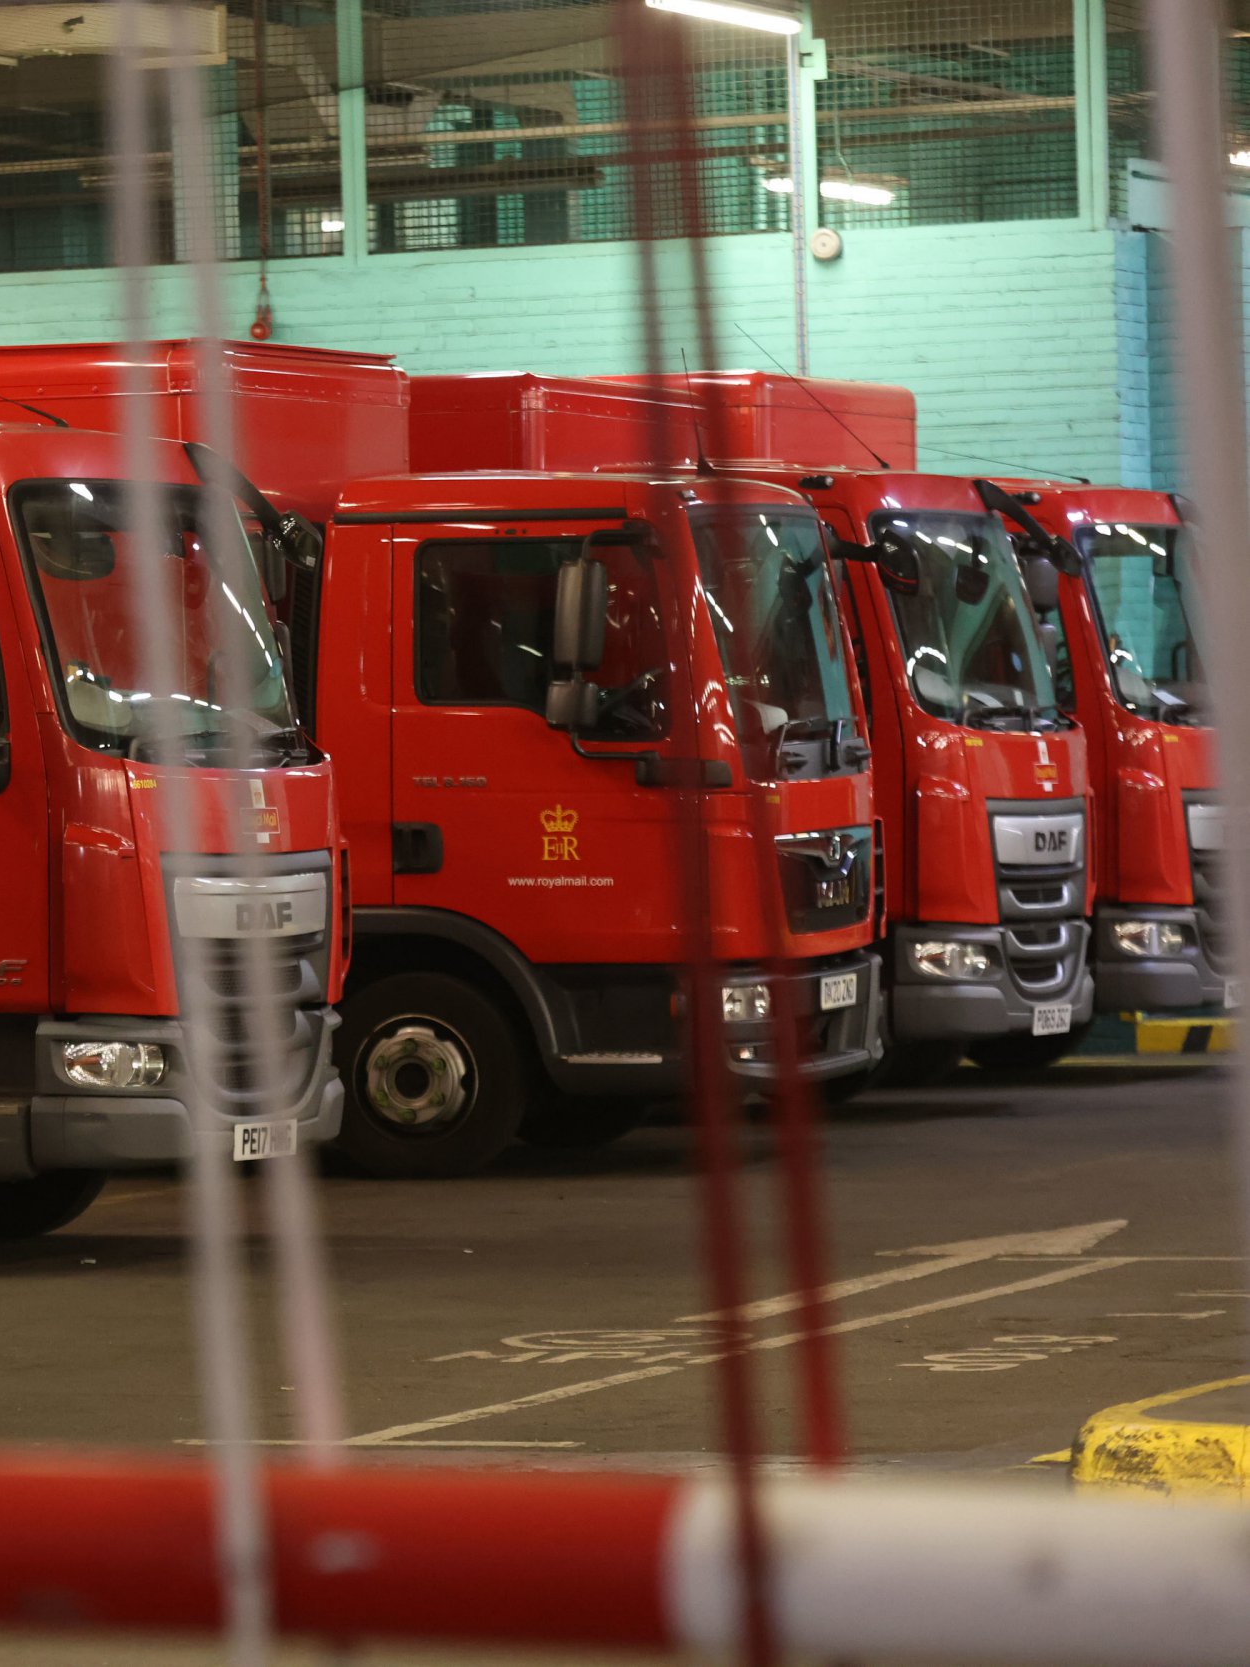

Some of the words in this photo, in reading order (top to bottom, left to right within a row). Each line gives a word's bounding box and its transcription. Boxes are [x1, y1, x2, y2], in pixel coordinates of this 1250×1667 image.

[1034, 831, 1067, 852] DAF
[507, 876, 615, 889] www.royalmail.com
[236, 901, 292, 931] DAF
[241, 1127, 268, 1156] PE17
